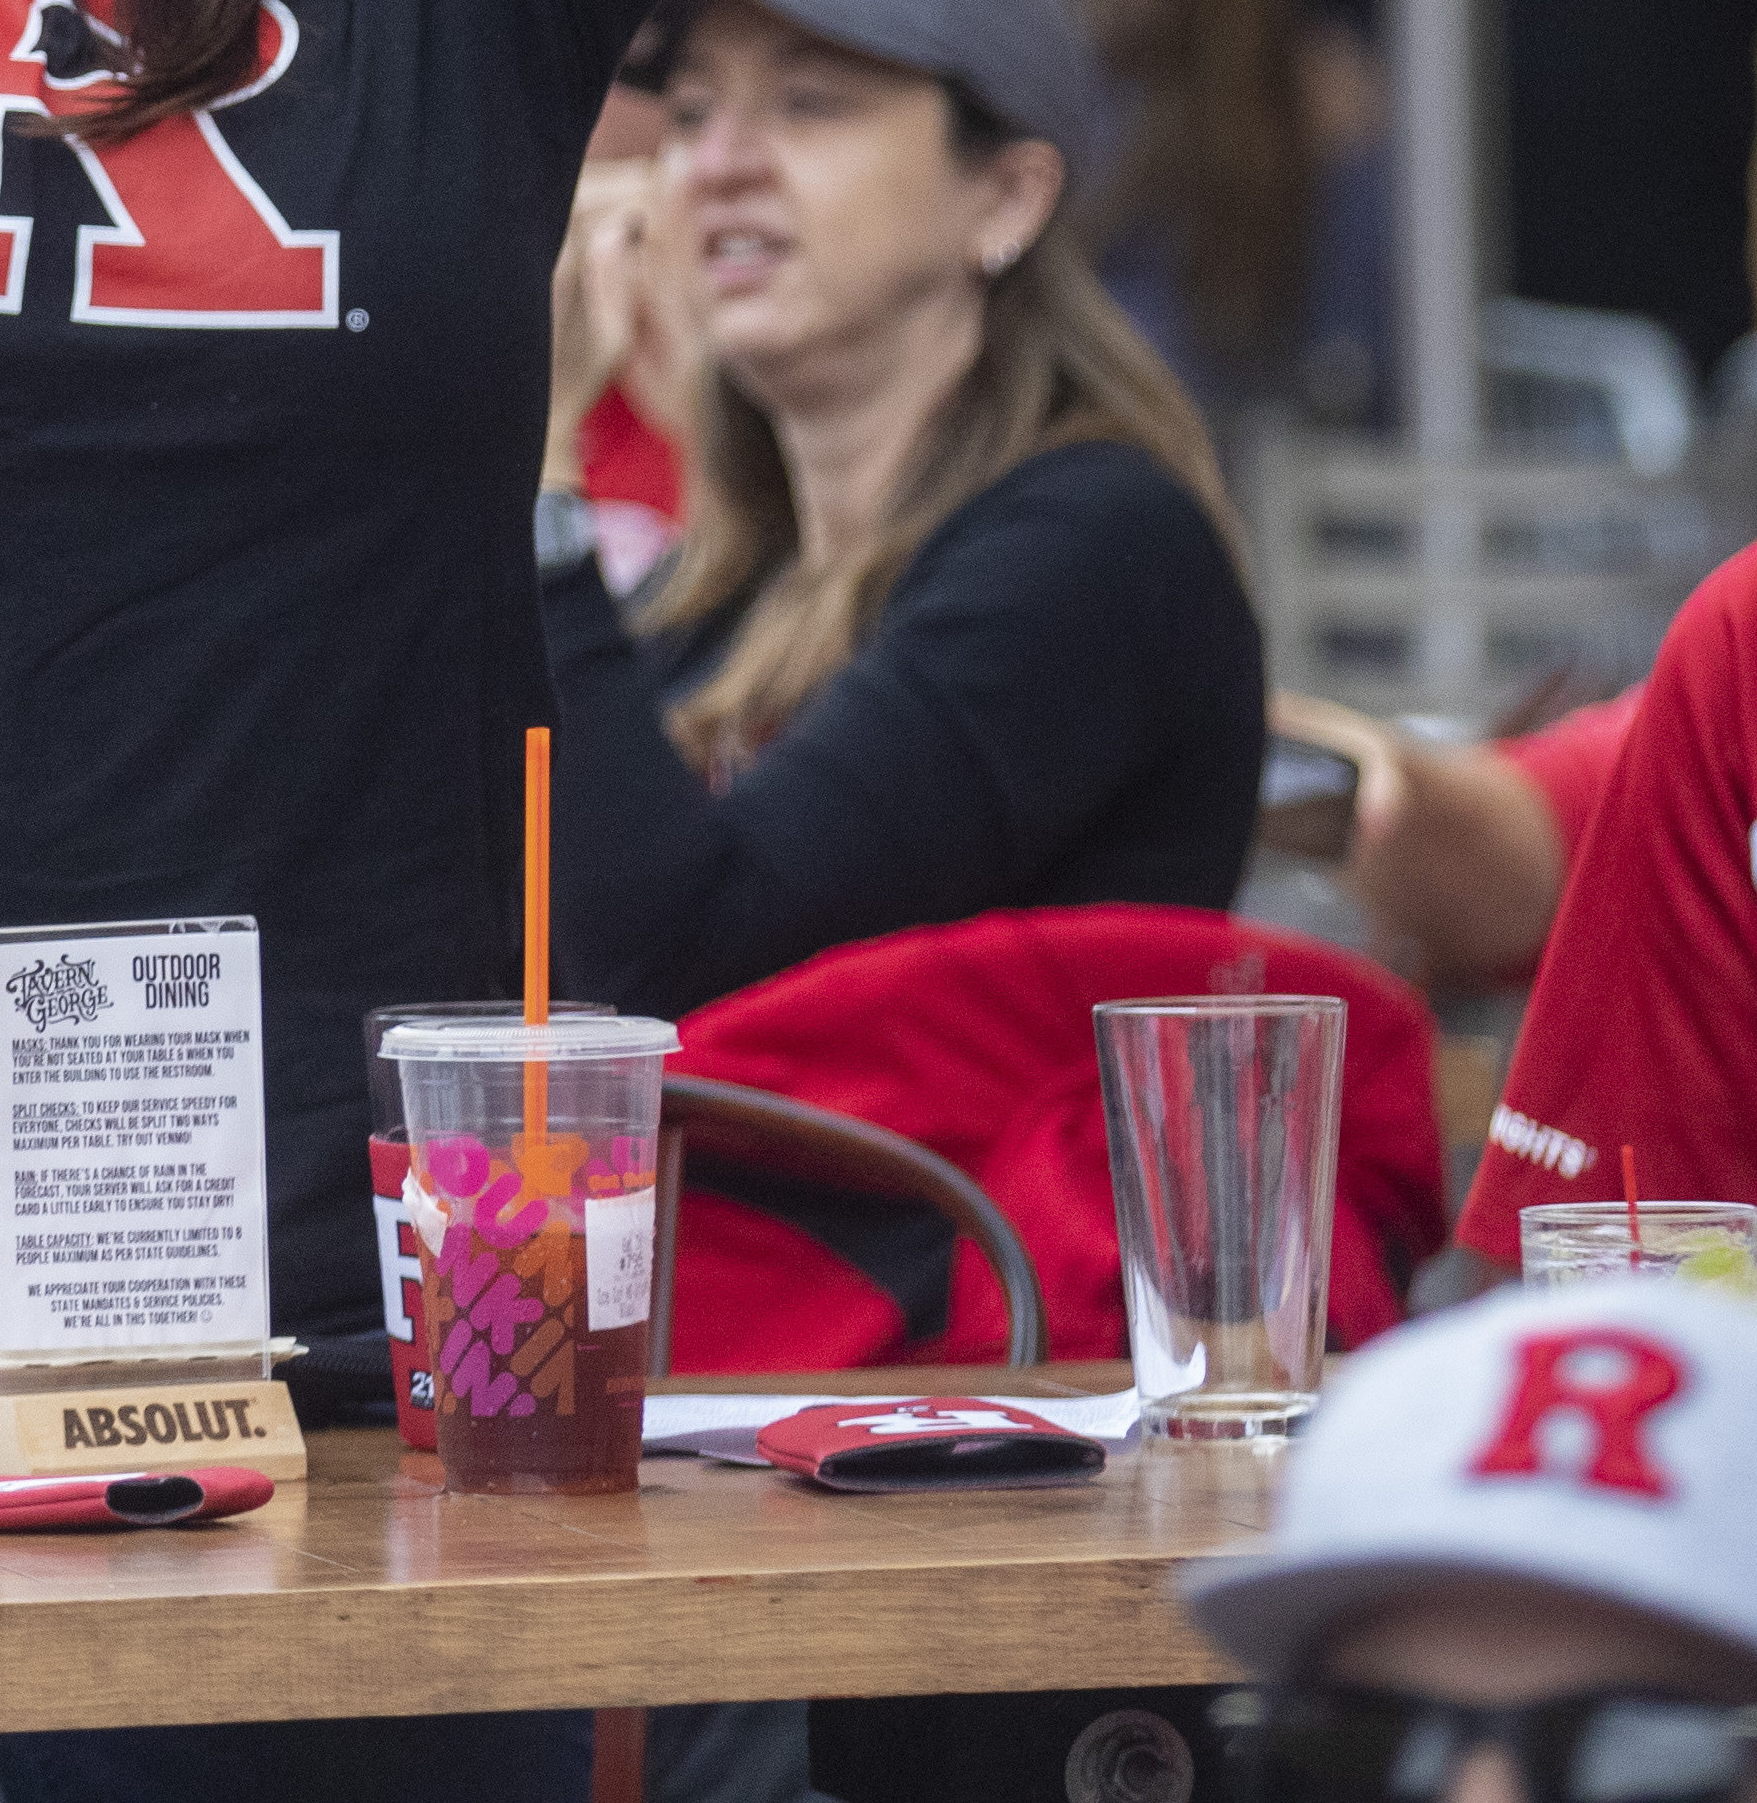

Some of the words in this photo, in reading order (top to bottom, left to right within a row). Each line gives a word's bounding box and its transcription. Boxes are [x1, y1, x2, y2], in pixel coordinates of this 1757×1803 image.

[6, 954, 99, 1007] TAVERN
[132, 953, 221, 982] OUTDOOR
[16, 985, 115, 1033] GEORGE
[145, 981, 210, 1009] DINING
[124, 1033, 165, 1047] WEARING
[1466, 1326, 1686, 1503] R
